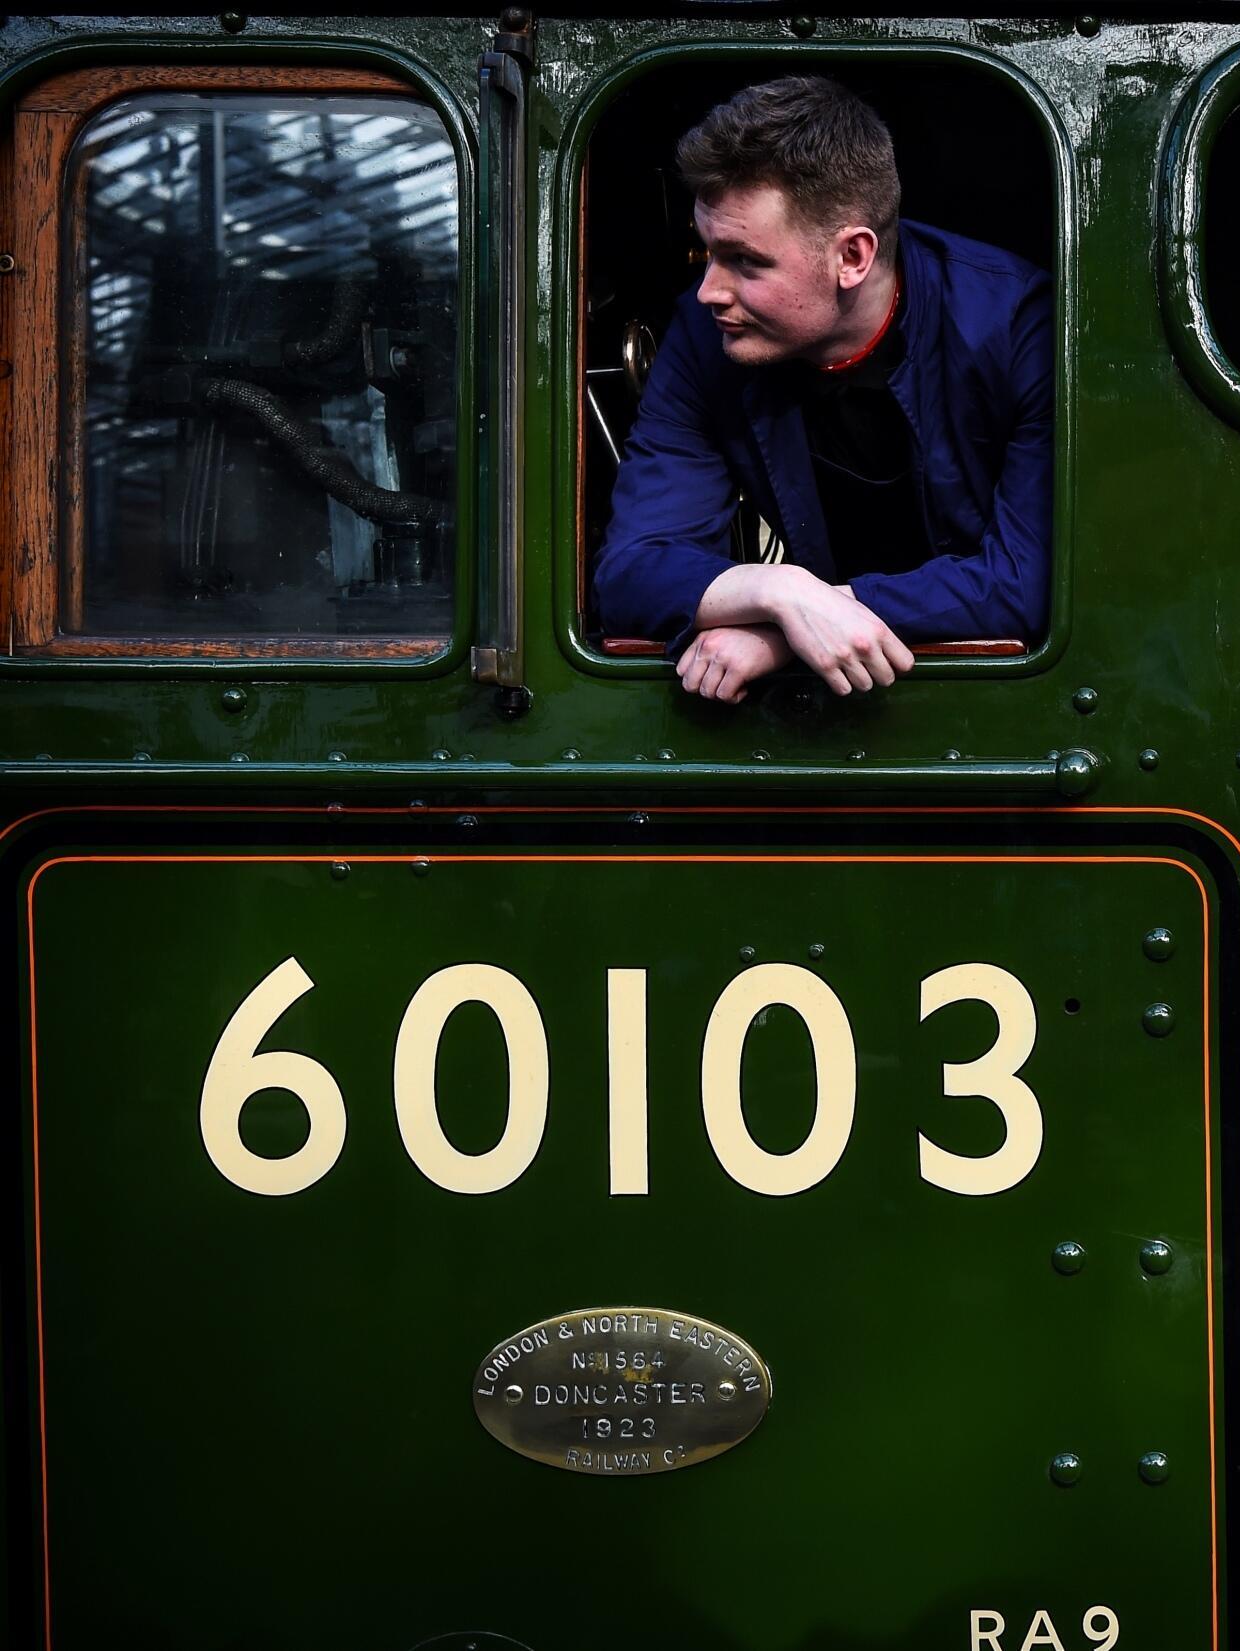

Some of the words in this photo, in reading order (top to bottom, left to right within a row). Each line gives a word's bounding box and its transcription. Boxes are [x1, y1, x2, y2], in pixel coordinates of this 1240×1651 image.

[199, 956, 1044, 1196] 60103
[477, 1328, 550, 1397] LONDON
[558, 1321, 574, 1340] &
[583, 1315, 658, 1335] NORTH
[669, 1320, 761, 1394] EASTERN
[534, 1382, 706, 1405] DONCASTER
[582, 1417, 657, 1439] 1923
[565, 1448, 651, 1470] RAILWAY
[970, 1605, 1120, 1651] RA9
